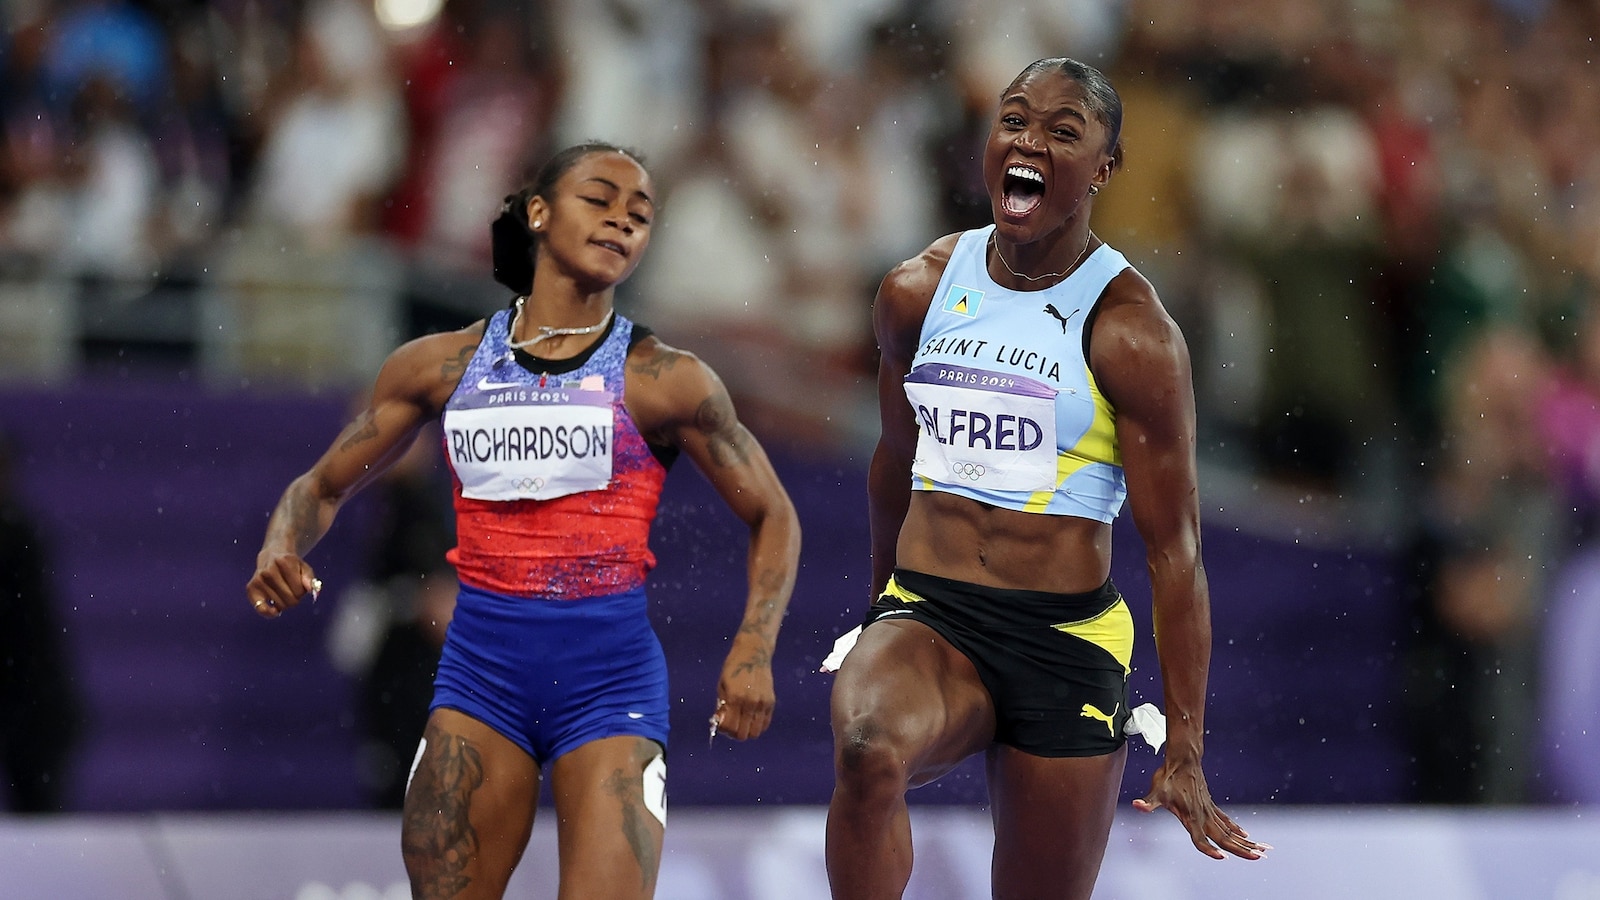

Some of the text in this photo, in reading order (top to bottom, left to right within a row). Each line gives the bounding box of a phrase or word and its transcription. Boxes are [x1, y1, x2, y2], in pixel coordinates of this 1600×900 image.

[921, 337, 1060, 382] SAINT LUCIA
[938, 369, 1015, 388] PARIS 2024
[488, 391, 570, 404] PARIS 2024
[451, 425, 607, 463] RICHARDSON
[918, 404, 1043, 451] ALFRED
